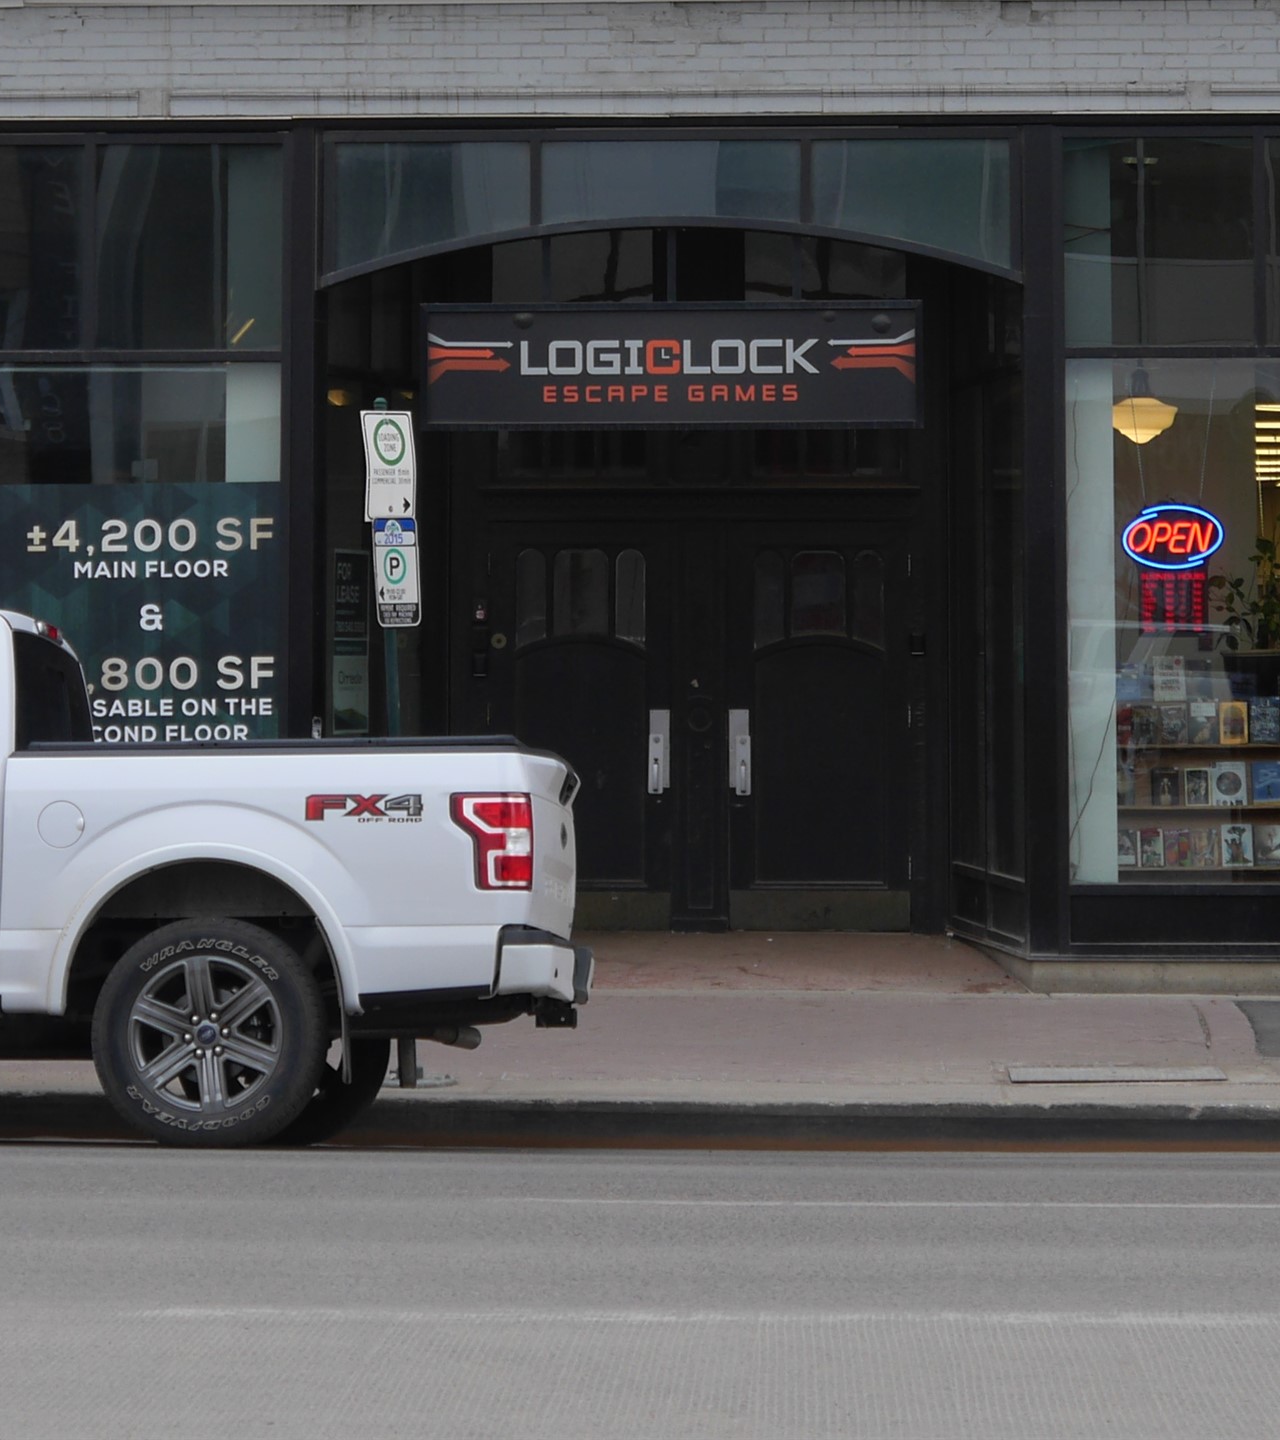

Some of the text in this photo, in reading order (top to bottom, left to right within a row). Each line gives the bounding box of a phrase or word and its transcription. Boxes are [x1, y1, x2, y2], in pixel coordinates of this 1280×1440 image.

[520, 338, 820, 376] LOGICLOCK
[542, 383, 800, 403] ESCAPE GAMES
[378, 433, 400, 442] LOADING
[383, 444, 398, 453] ZONE
[27, 517, 275, 557] ±4,200 SF
[383, 533, 404, 545] 2015
[1127, 521, 1215, 554] OPEN
[73, 560, 230, 579] MAIN FLOOR
[389, 556, 401, 577] P
[138, 604, 164, 631] &
[87, 655, 275, 695] ,800 SF
[92, 698, 273, 718] SABLE ON THE
[92, 724, 249, 742] COND FLOOR
[305, 793, 424, 821] FX4
[139, 937, 281, 983] WRANGLER
